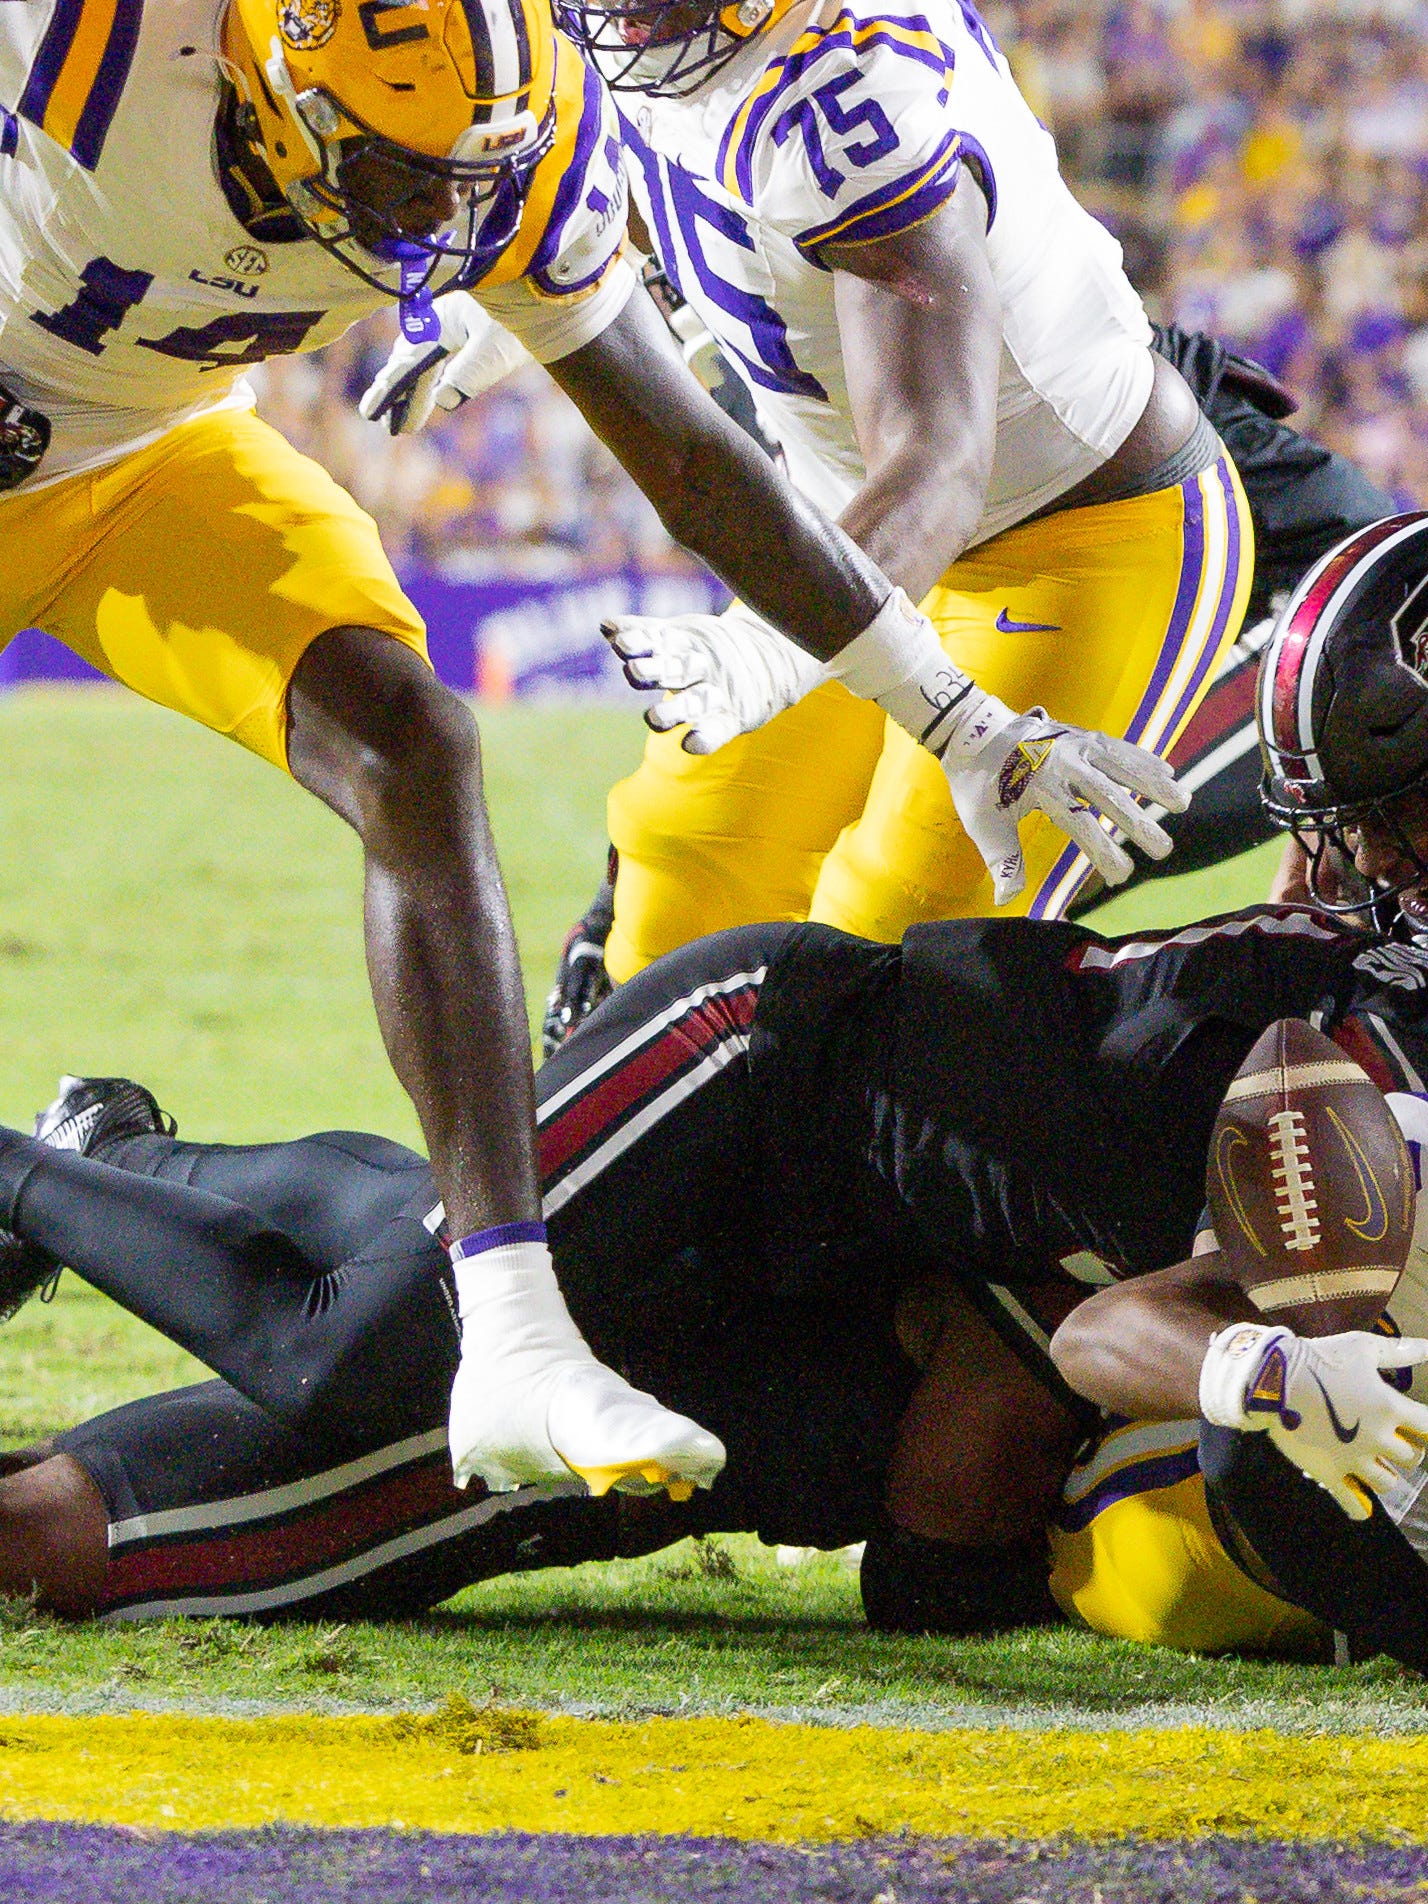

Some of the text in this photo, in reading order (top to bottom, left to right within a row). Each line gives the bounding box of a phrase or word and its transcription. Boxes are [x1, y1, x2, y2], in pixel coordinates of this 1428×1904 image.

[769, 67, 901, 201] 75
[28, 255, 330, 374] 14
[188, 267, 260, 299] LSU
